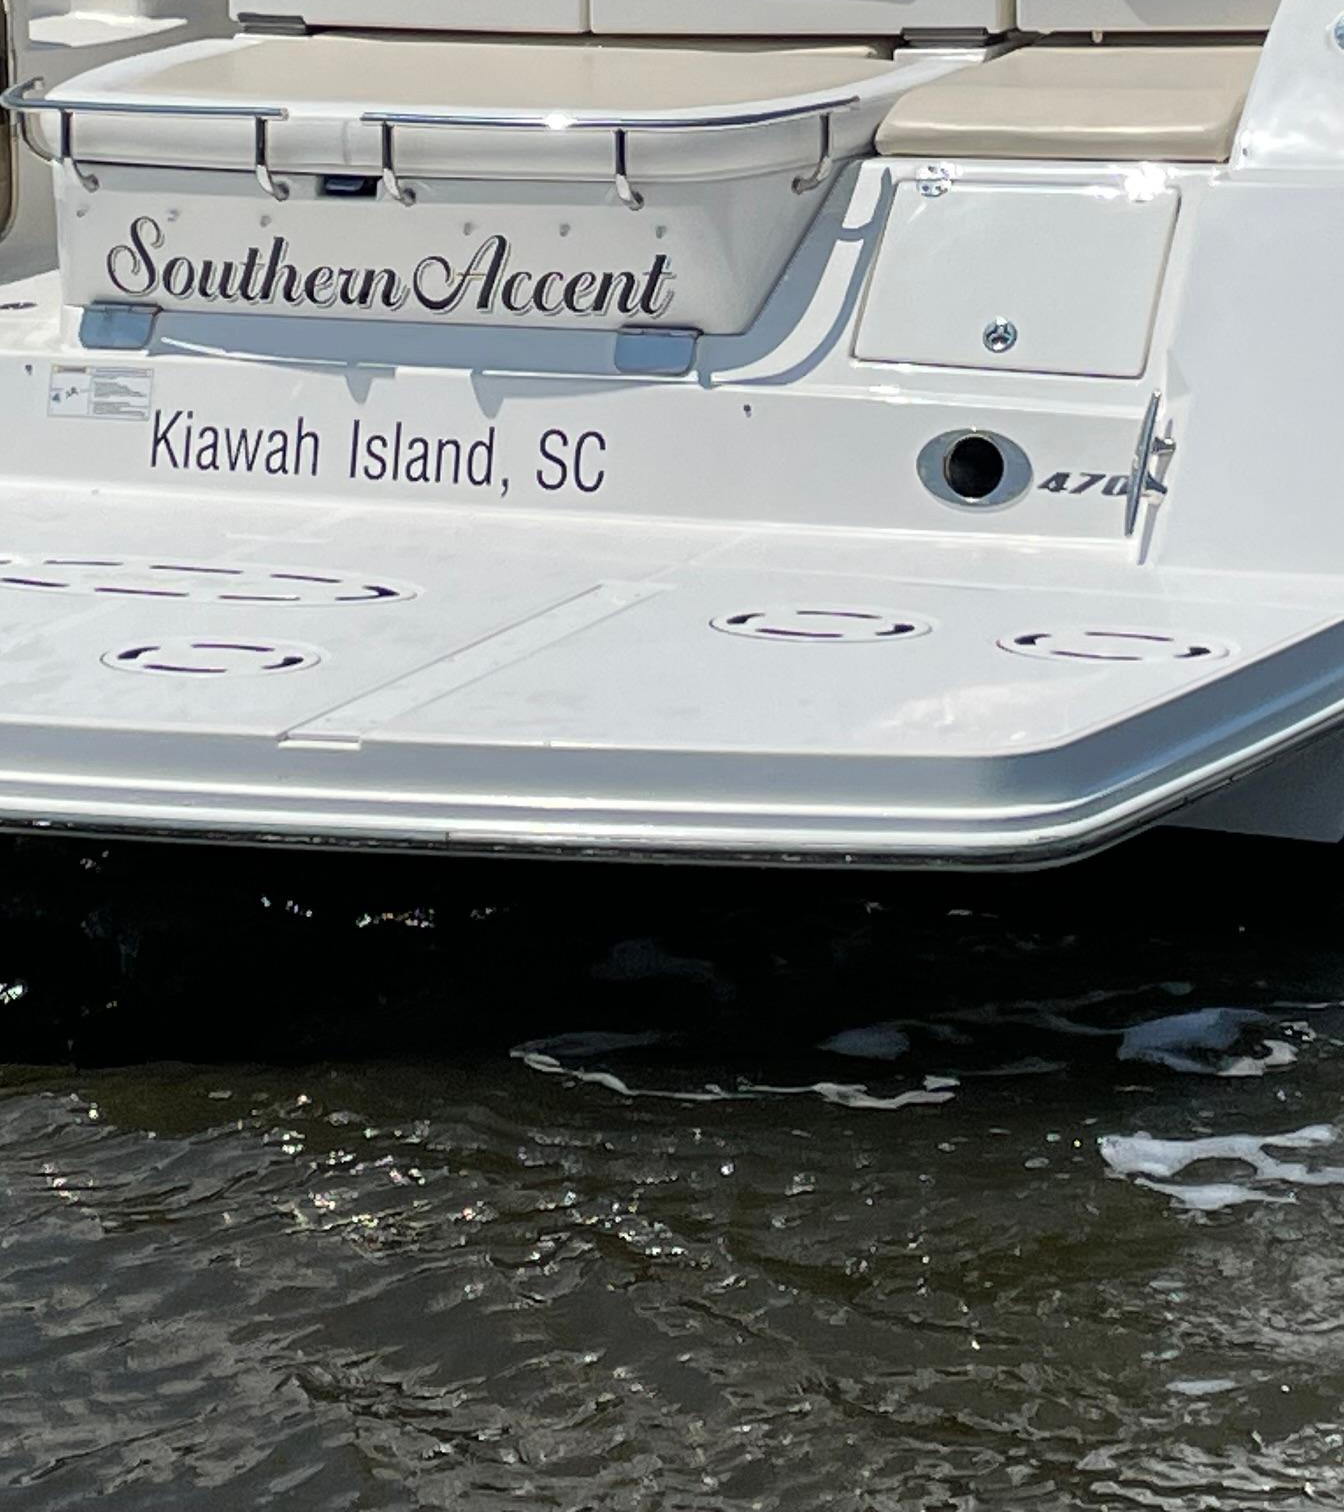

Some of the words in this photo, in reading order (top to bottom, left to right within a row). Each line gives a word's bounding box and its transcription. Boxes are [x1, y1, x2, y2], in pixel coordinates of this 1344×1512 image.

[106, 215, 409, 310] Southern
[412, 234, 676, 317] Accent
[150, 410, 320, 476] Kiawah
[348, 418, 510, 497] Island,
[536, 428, 607, 493] SC
[1036, 472, 1131, 497] 470
